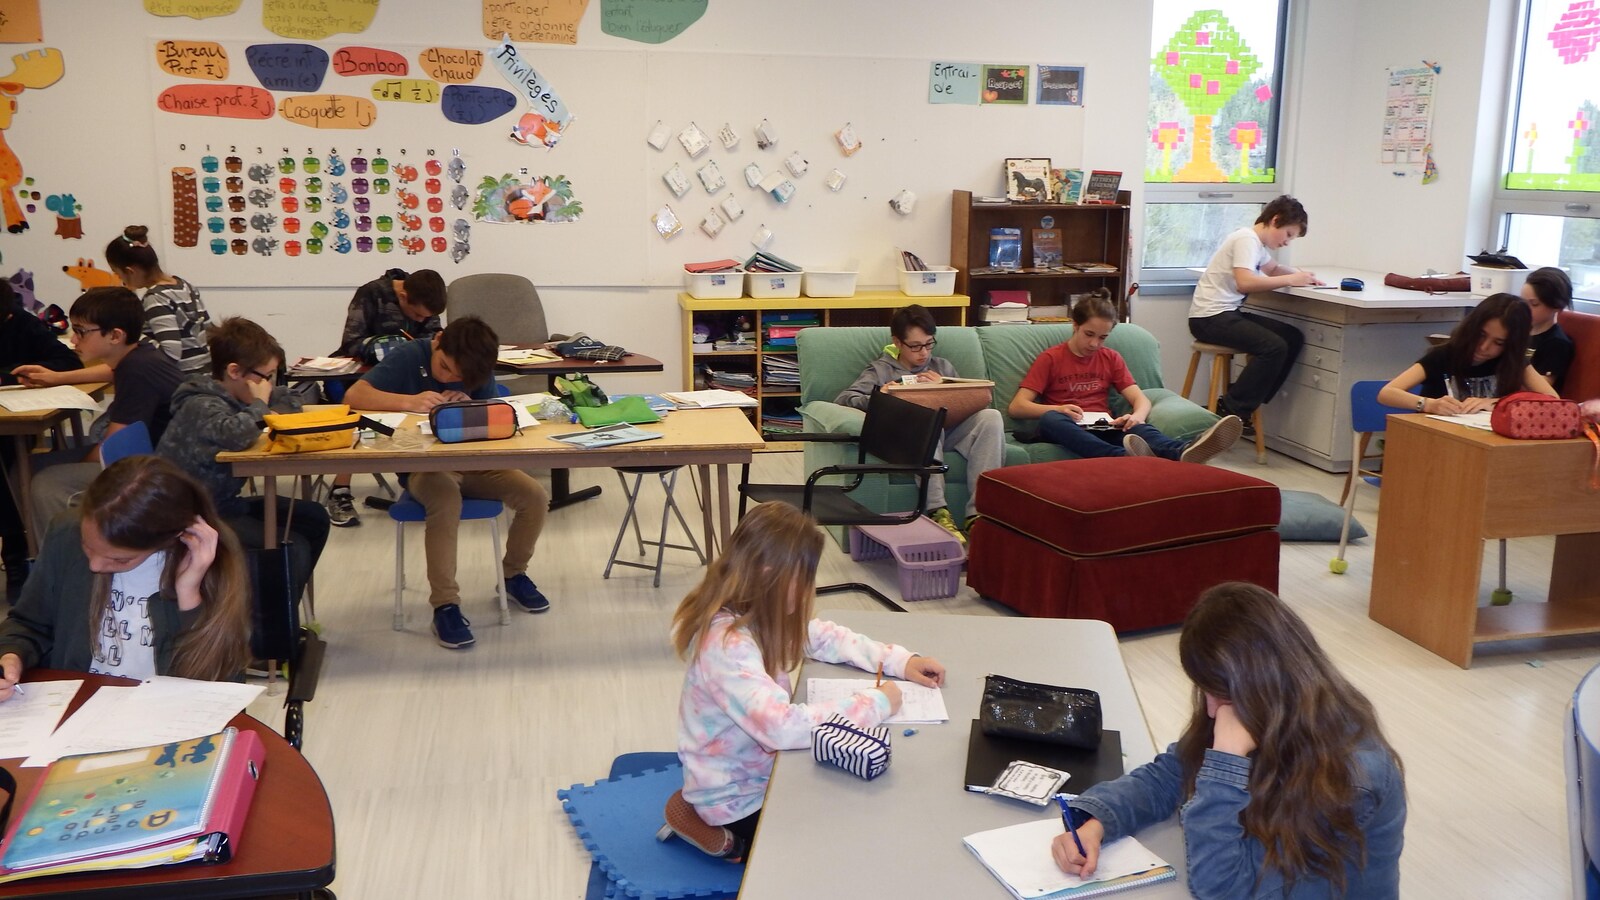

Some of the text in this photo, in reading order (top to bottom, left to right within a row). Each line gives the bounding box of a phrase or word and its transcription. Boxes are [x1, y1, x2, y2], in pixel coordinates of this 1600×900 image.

[489, 2, 549, 19] participer
[432, 65, 474, 83] chaud
[497, 44, 558, 113] Privilèges
[179, 143, 186, 151] 0
[307, 147, 313, 155] 5
[1069, 380, 1101, 393] VANS
[59, 811, 172, 841] Agenda
